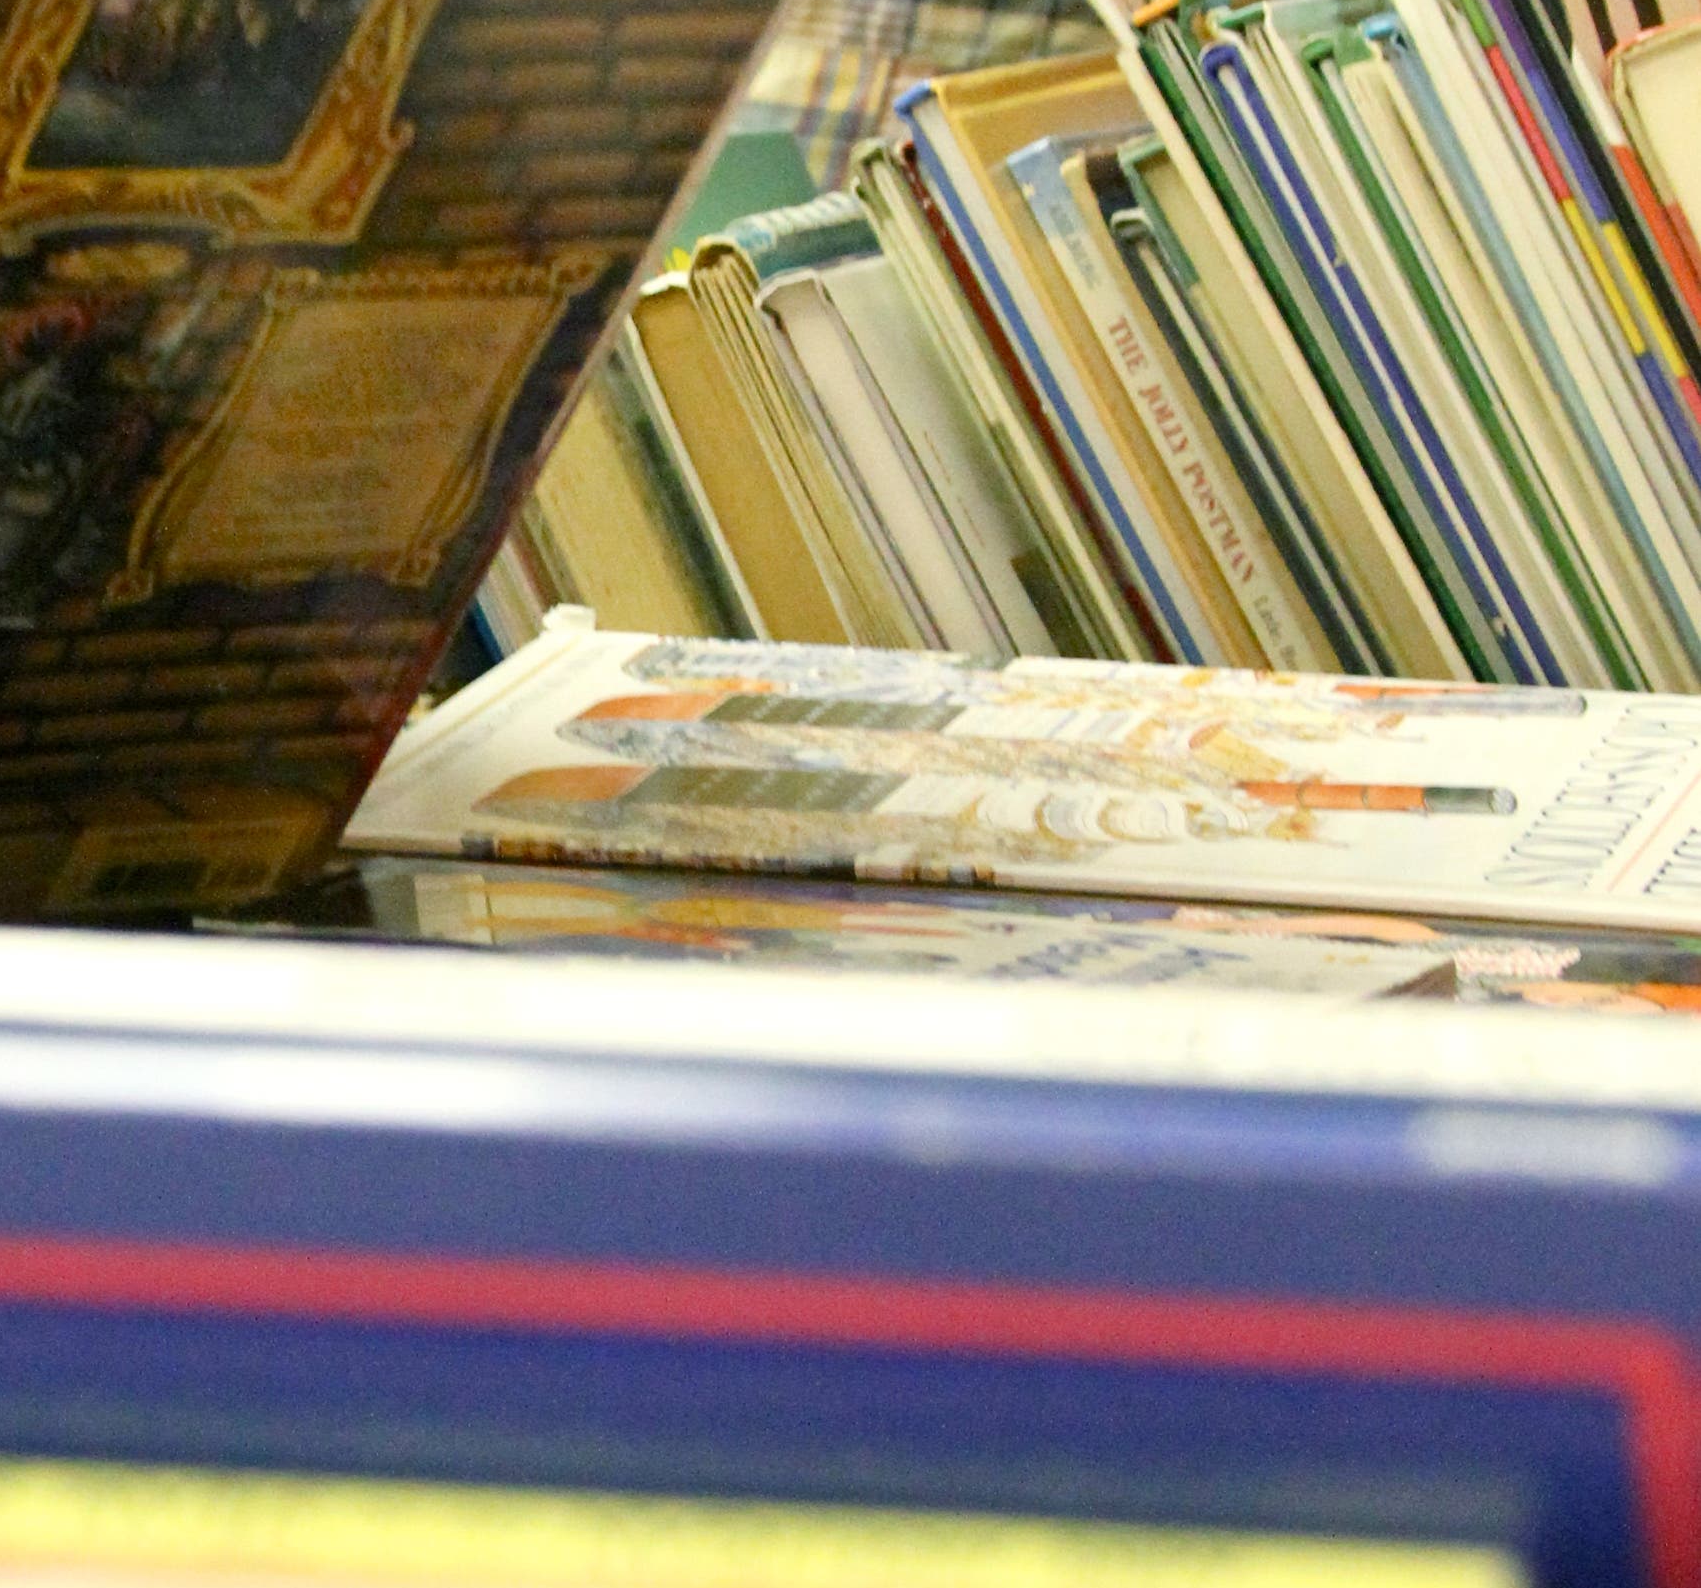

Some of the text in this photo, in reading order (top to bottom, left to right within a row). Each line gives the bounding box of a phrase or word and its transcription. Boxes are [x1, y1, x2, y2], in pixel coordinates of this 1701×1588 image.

[1108, 315, 1146, 374] THE
[1138, 382, 1189, 456] JOLLY
[1182, 461, 1255, 583] POSTMAN
